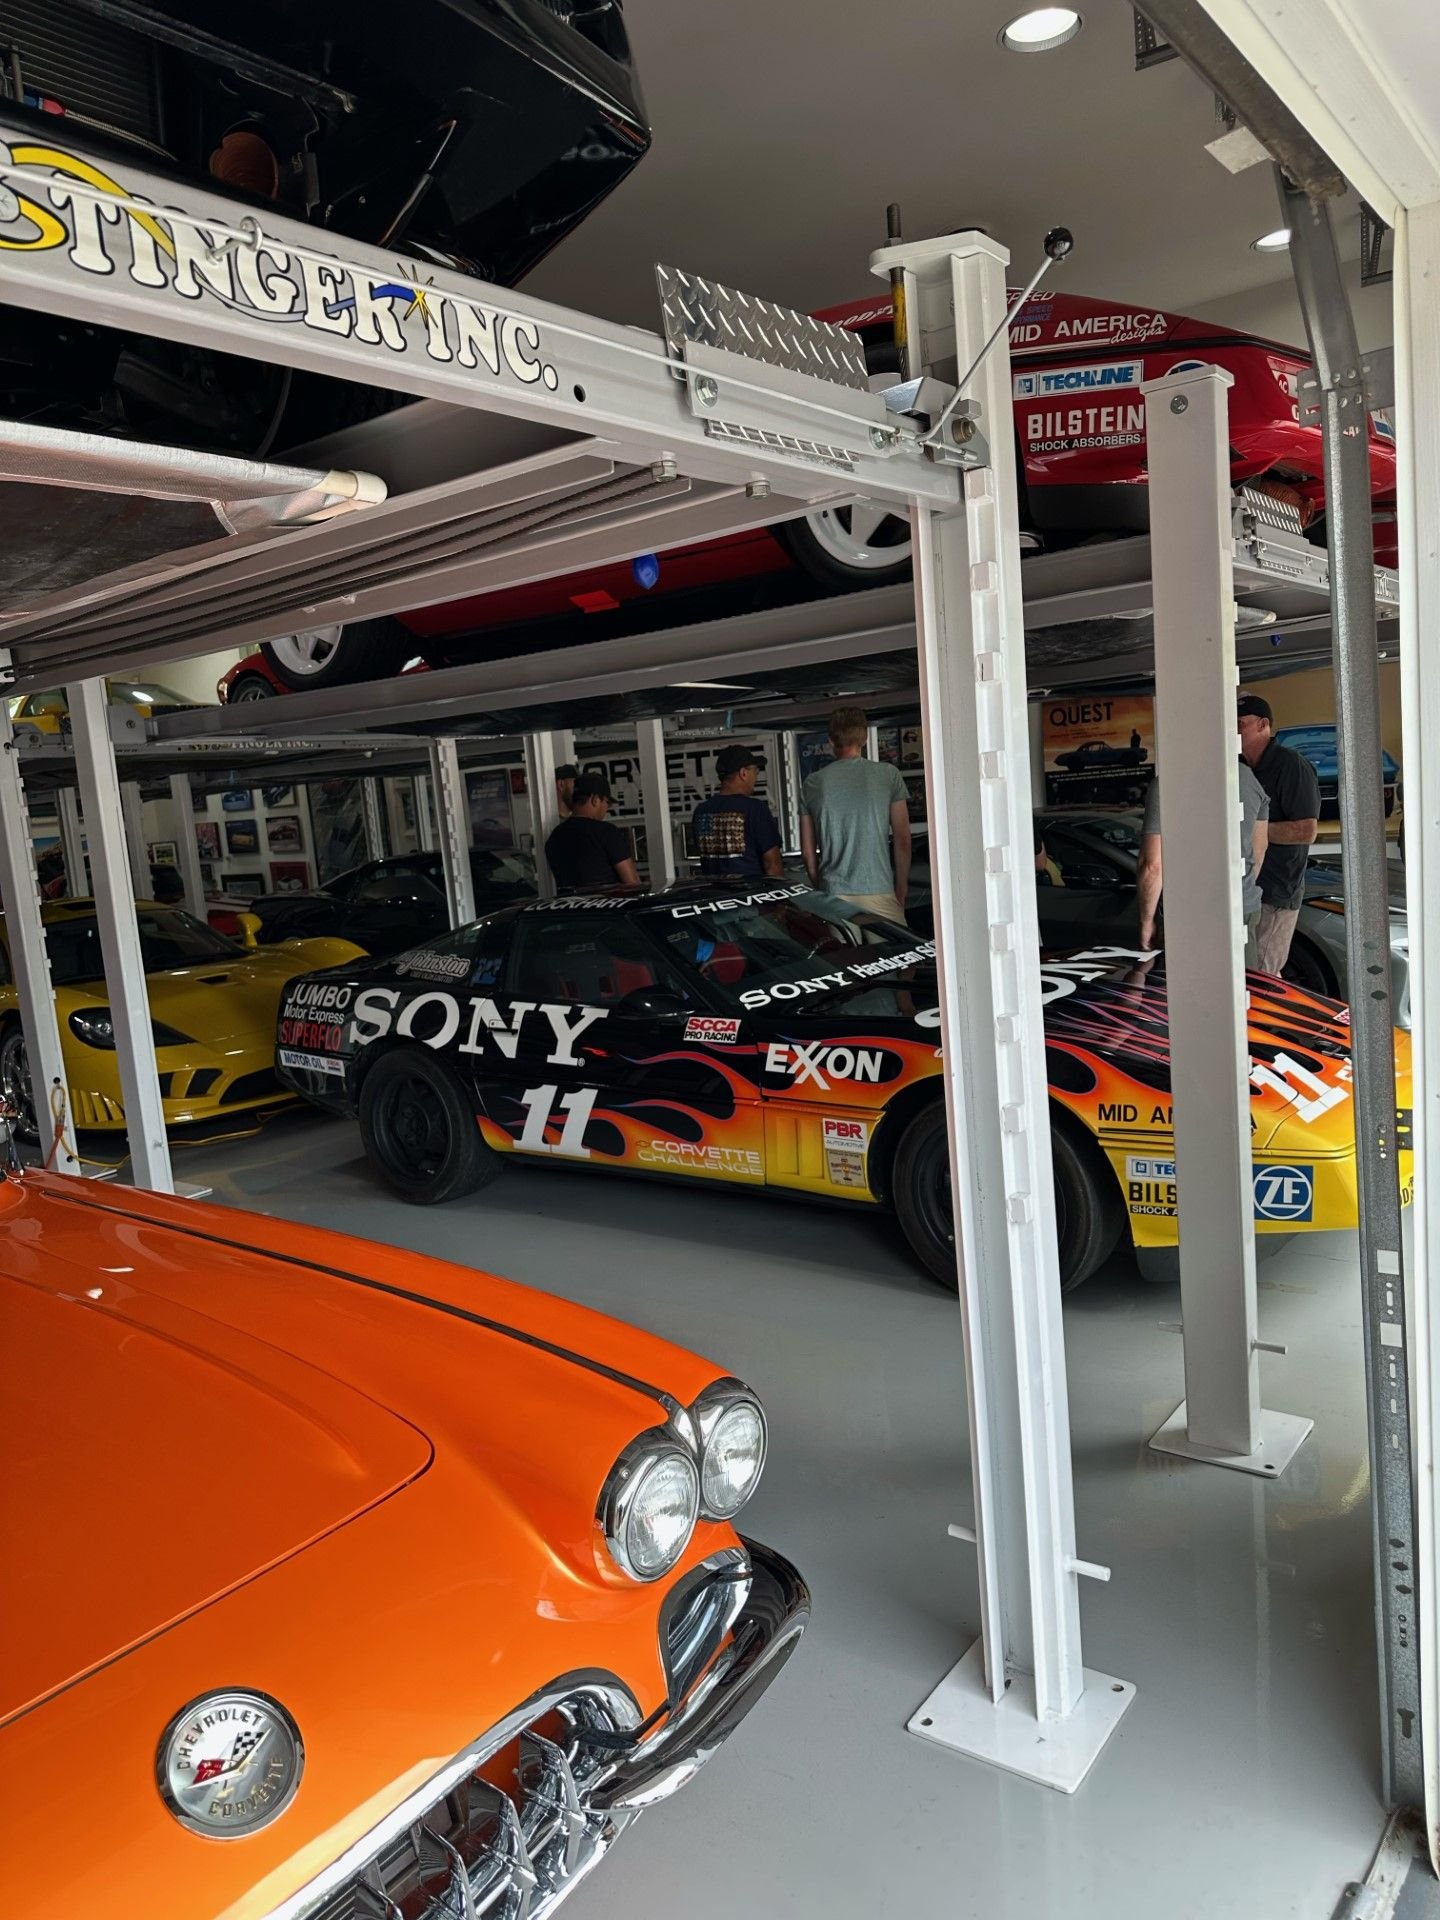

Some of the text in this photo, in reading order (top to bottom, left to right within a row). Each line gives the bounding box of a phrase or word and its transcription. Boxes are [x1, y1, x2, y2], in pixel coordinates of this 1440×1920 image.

[424, 290, 559, 392] INC.
[1009, 313, 1168, 344] MID AMERICA
[1110, 325, 1166, 345] designs
[1042, 366, 1134, 391] TECHLINE
[1027, 404, 1144, 440] BILSTEIN
[1029, 434, 1141, 453] SHOCK ABSORBERS
[1049, 702, 1113, 727] QUEST
[523, 898, 639, 911] LOCKHART
[671, 884, 813, 919] CHEVROLET
[739, 971, 852, 1010] SONY
[846, 951, 926, 979] Handycam
[287, 983, 351, 1009] JUMBO
[284, 1004, 345, 1025] Motor Express
[349, 987, 610, 1067] SONY
[687, 1018, 738, 1033] SCCA
[281, 1020, 342, 1052] SUPERFLO
[684, 1030, 737, 1043] PRO RACING
[284, 1052, 311, 1067] MOTOR
[312, 1057, 325, 1069] OIL
[764, 1040, 883, 1091] EXXON
[512, 1083, 598, 1158] 11
[1098, 1103, 1138, 1122] MID
[825, 1120, 863, 1139] PBR
[651, 1140, 760, 1164] CORVETTE
[826, 1140, 865, 1149] AUTOMOTIVE
[637, 1150, 764, 1176] CHALLENGE
[1129, 1182, 1177, 1204] BILS
[1132, 1205, 1169, 1216] SHOCK
[176, 1708, 264, 1770] CHEVROLET
[208, 1756, 284, 1818] CORVETTE
